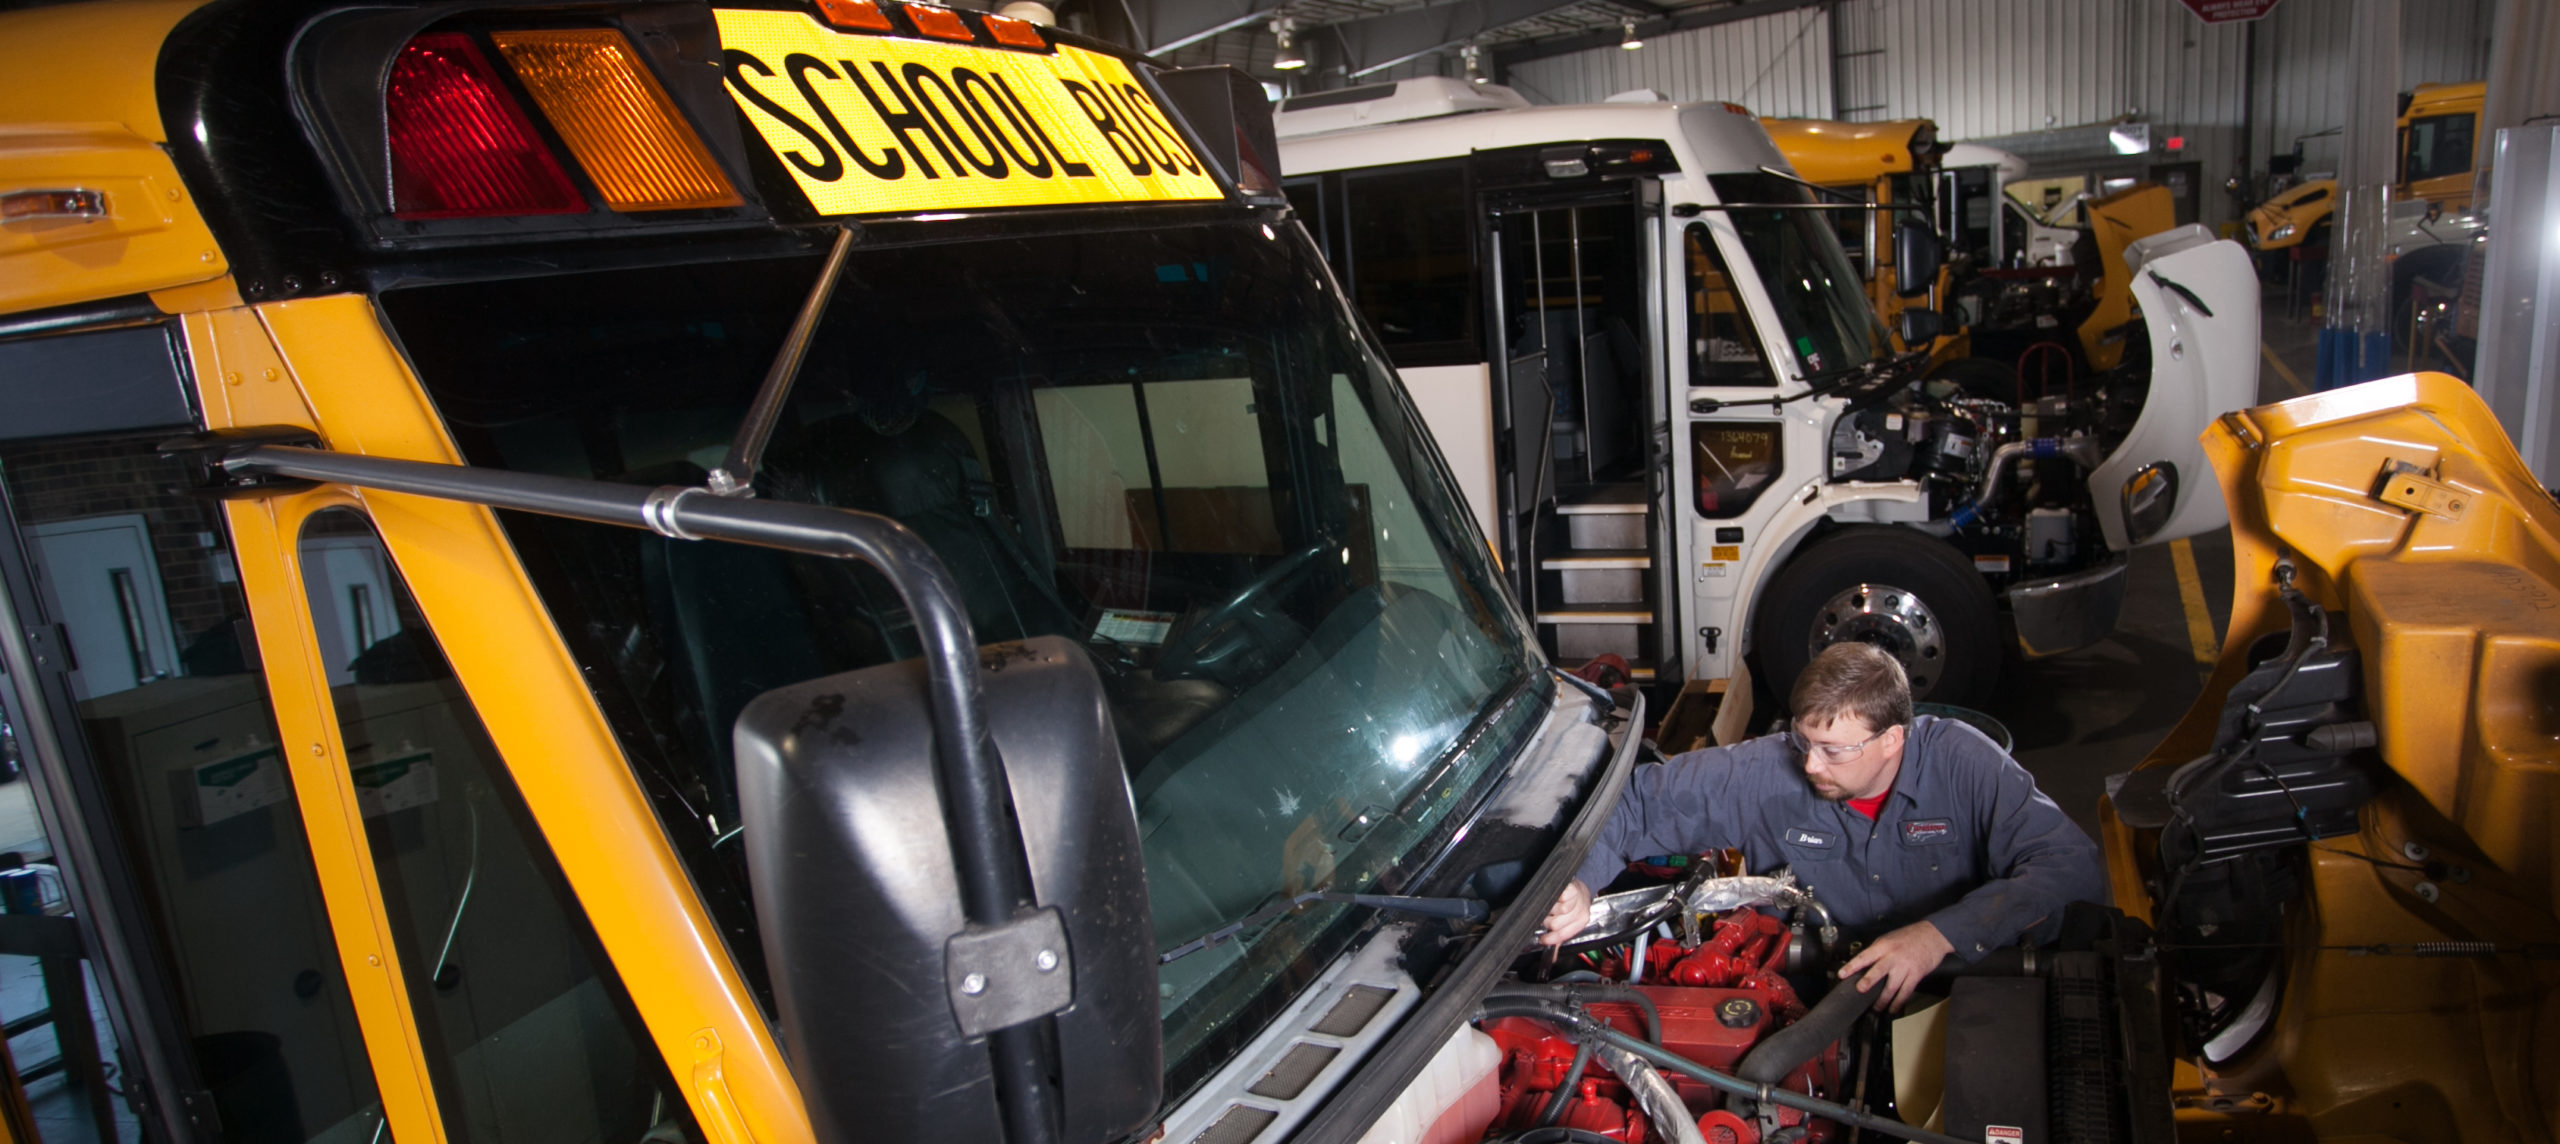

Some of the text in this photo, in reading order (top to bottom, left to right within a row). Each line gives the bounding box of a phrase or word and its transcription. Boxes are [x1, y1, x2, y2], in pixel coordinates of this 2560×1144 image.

[2202, 2, 2230, 12] ALWAYS
[2232, 0, 2253, 8] WEAR
[2212, 8, 2257, 18] PROTECTION
[723, 49, 1202, 182] SCHOOL BUS
[1799, 833, 1823, 845] Brian
[1995, 1128, 2020, 1137] DANGER
